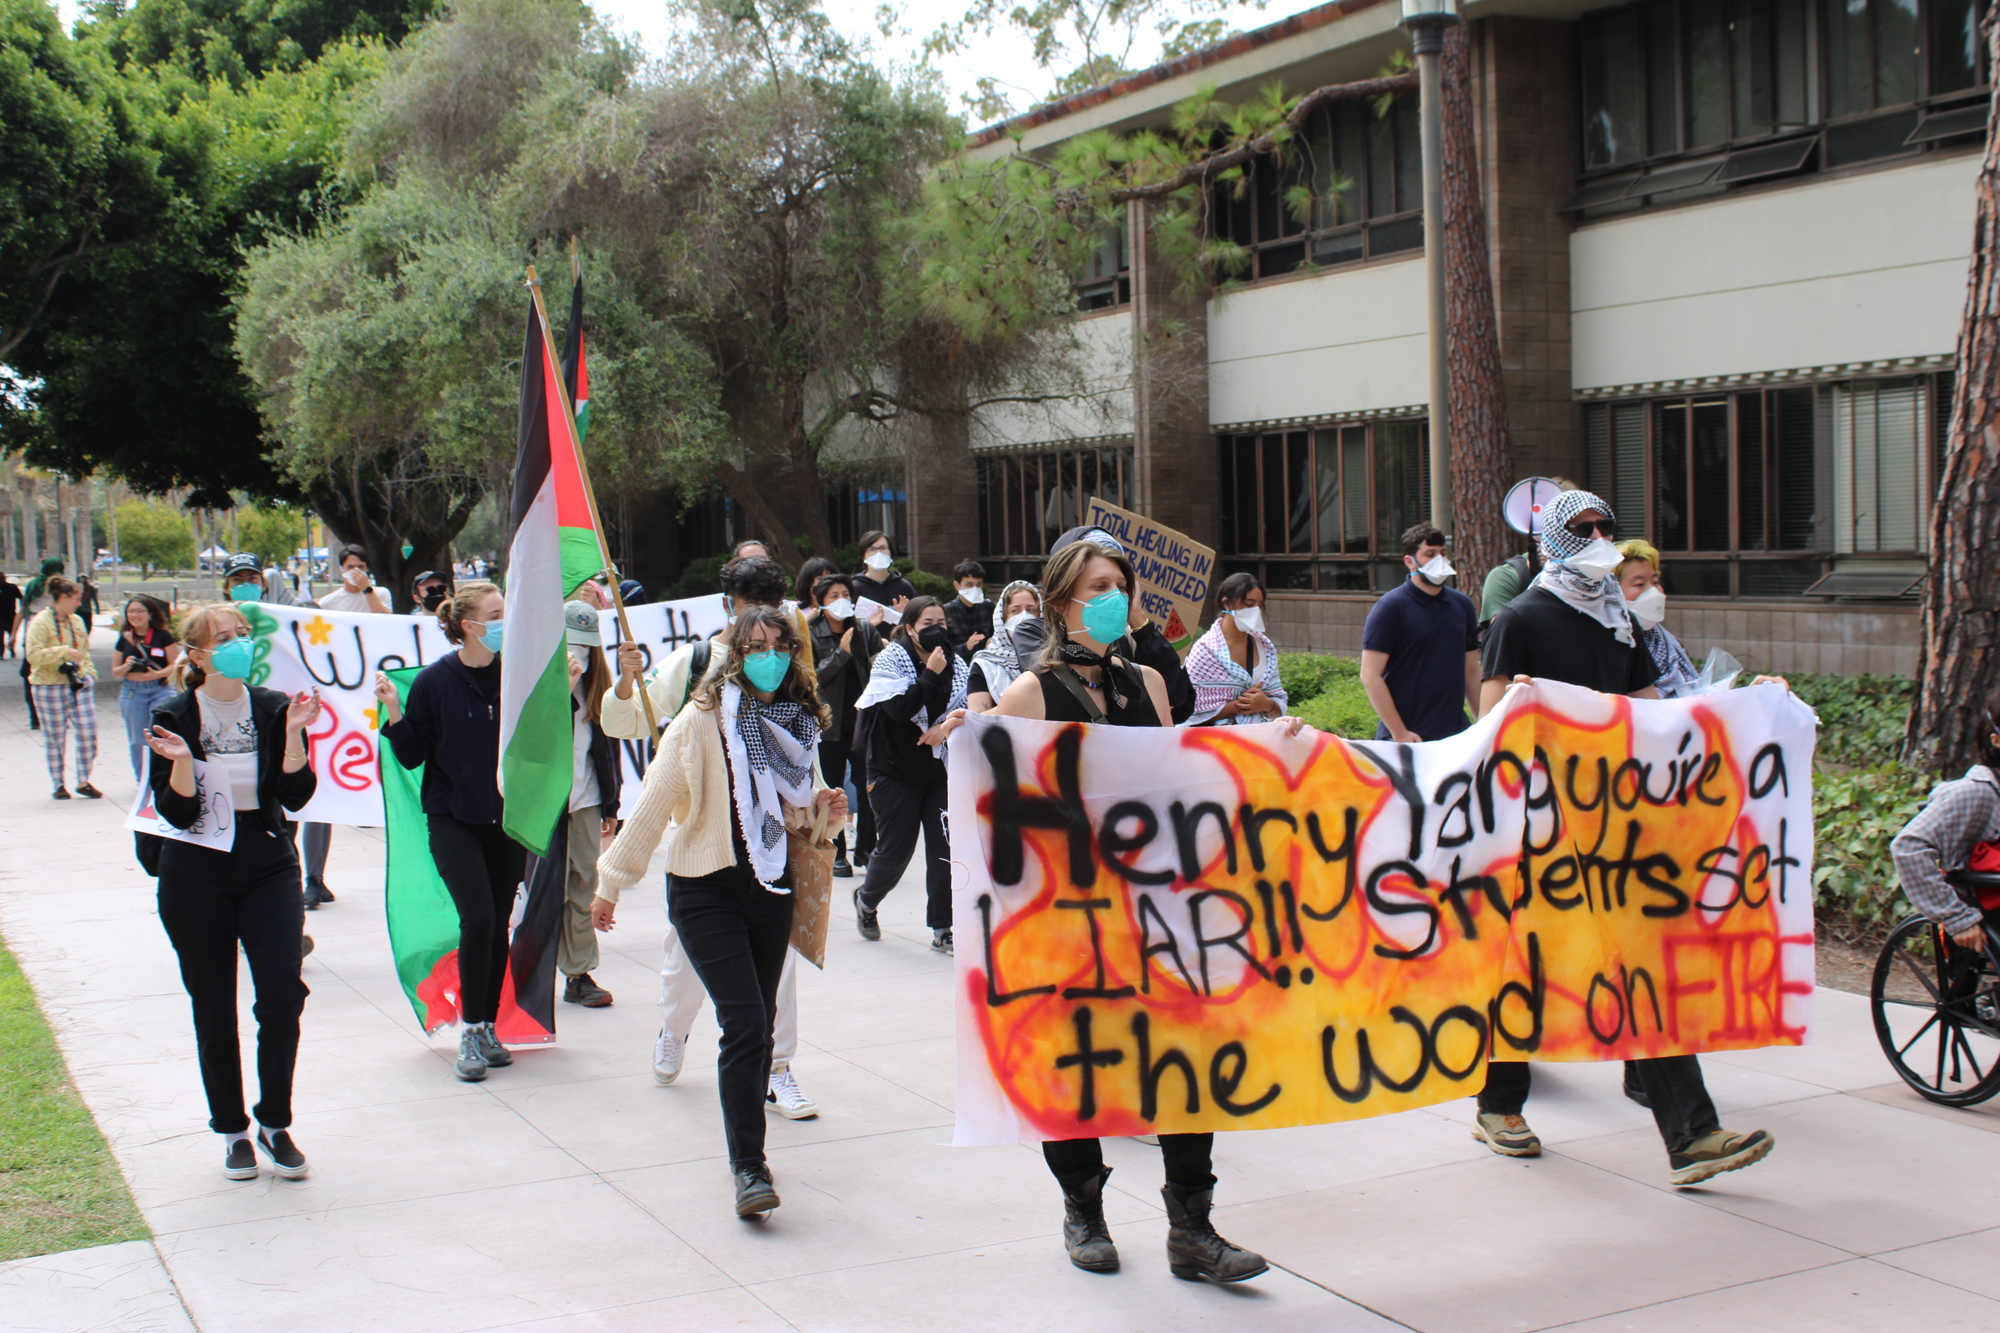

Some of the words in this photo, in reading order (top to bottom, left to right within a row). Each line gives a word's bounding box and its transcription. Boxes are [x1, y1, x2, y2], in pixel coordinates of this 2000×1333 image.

[1091, 505, 1133, 543] TOTAL
[1134, 525, 1192, 568] HEALING
[1192, 553, 1212, 576] IN
[1122, 545, 1207, 602] RAUMATIZED
[1140, 590, 1174, 620] HERE
[979, 722, 1358, 920] Henry
[1346, 742, 1562, 858] Yang
[1748, 742, 1790, 800] a
[976, 878, 1315, 1007] LIAR!!
[1694, 817, 1801, 913] set
[1055, 1005, 1283, 1123] the
[1586, 963, 1665, 1046] on
[1662, 930, 1815, 1046] FIRE
